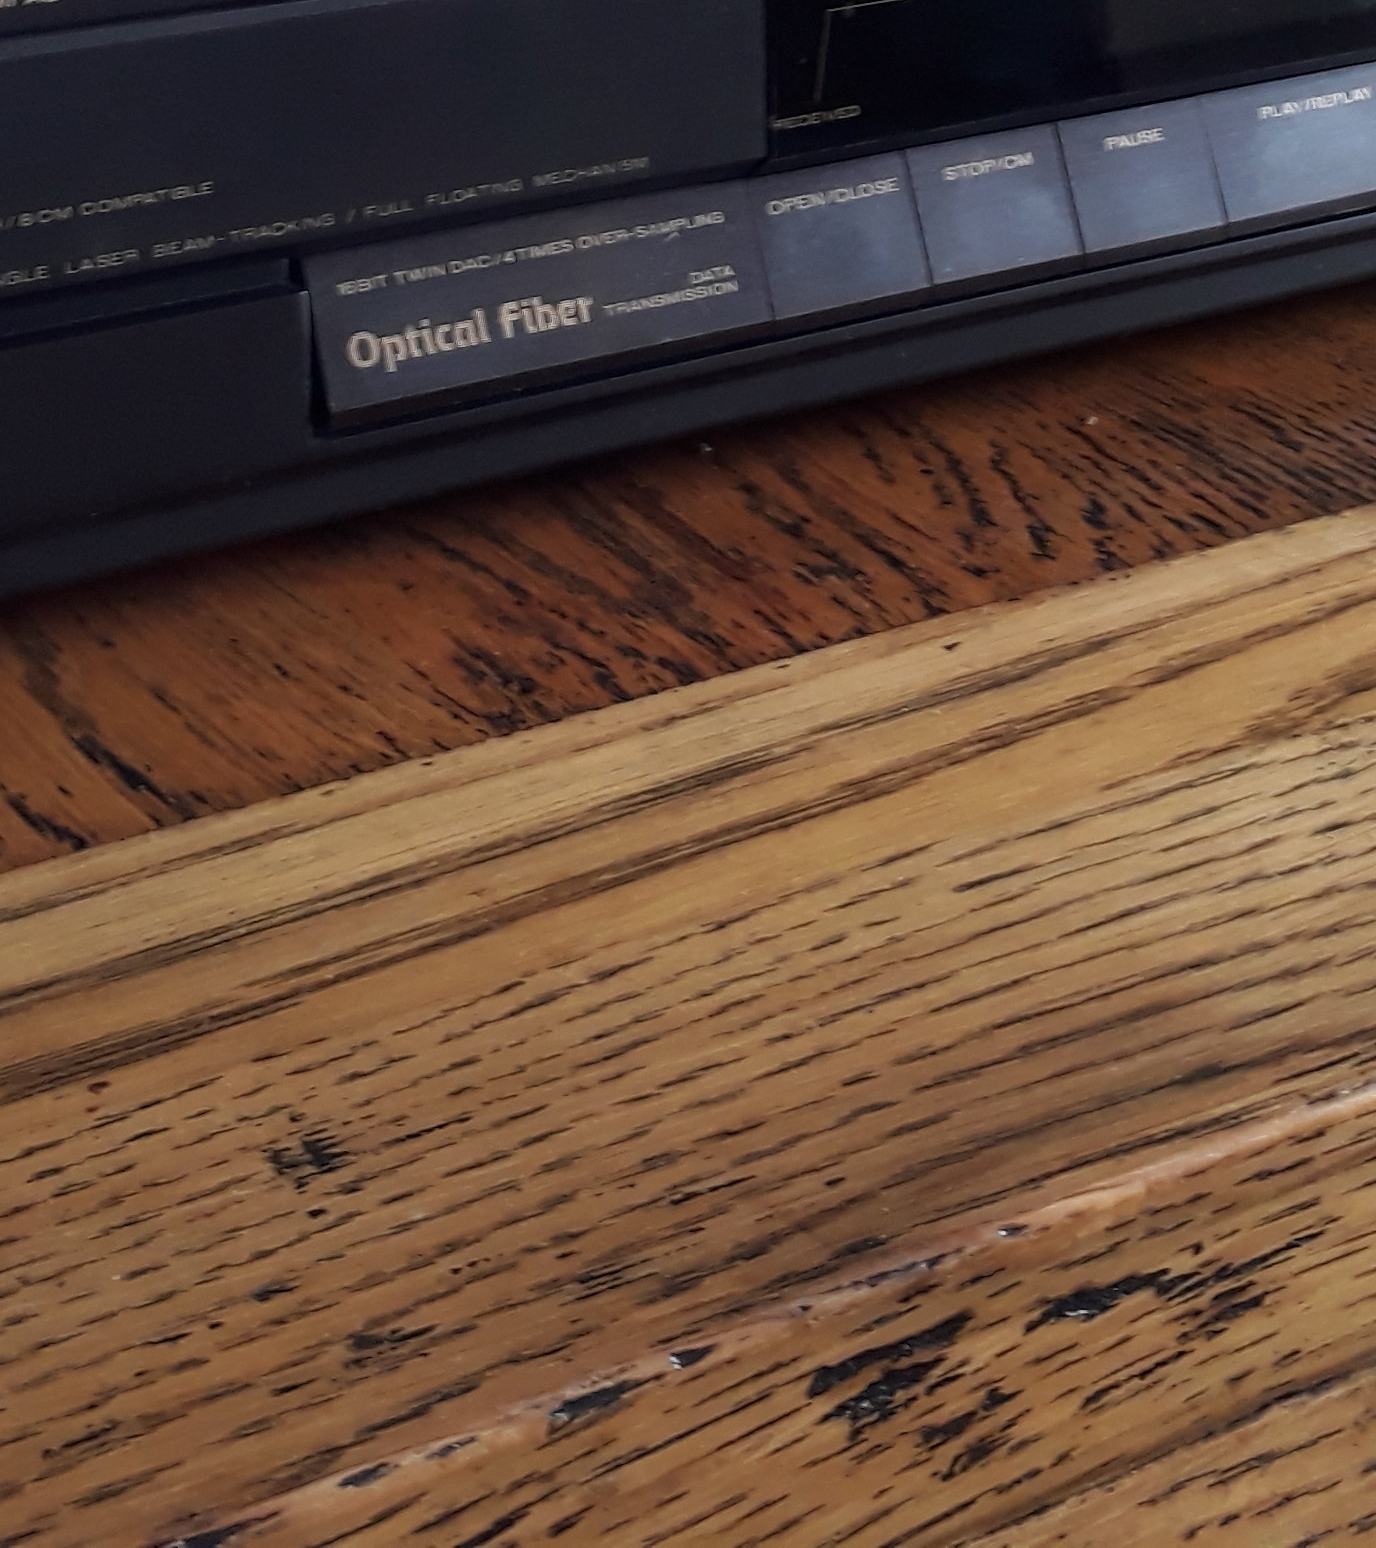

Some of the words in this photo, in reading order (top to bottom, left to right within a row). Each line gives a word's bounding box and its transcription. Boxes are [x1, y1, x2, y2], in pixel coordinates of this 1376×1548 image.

[1257, 86, 1373, 120] PLAY/REPLAY
[1103, 126, 1166, 153] PAUSE
[77, 181, 215, 218] COMPATIBLE
[765, 177, 901, 215] OPEN/CLOSE
[62, 248, 140, 275] LASER
[362, 199, 415, 221] FULL
[425, 178, 524, 207] FLOATING
[530, 156, 651, 188] MECHANISM
[392, 260, 447, 286] TWIN
[686, 263, 737, 286] DATA
[601, 279, 740, 317] TRANSMISSION
[345, 307, 492, 374] Optical
[496, 294, 596, 340] Fiber
